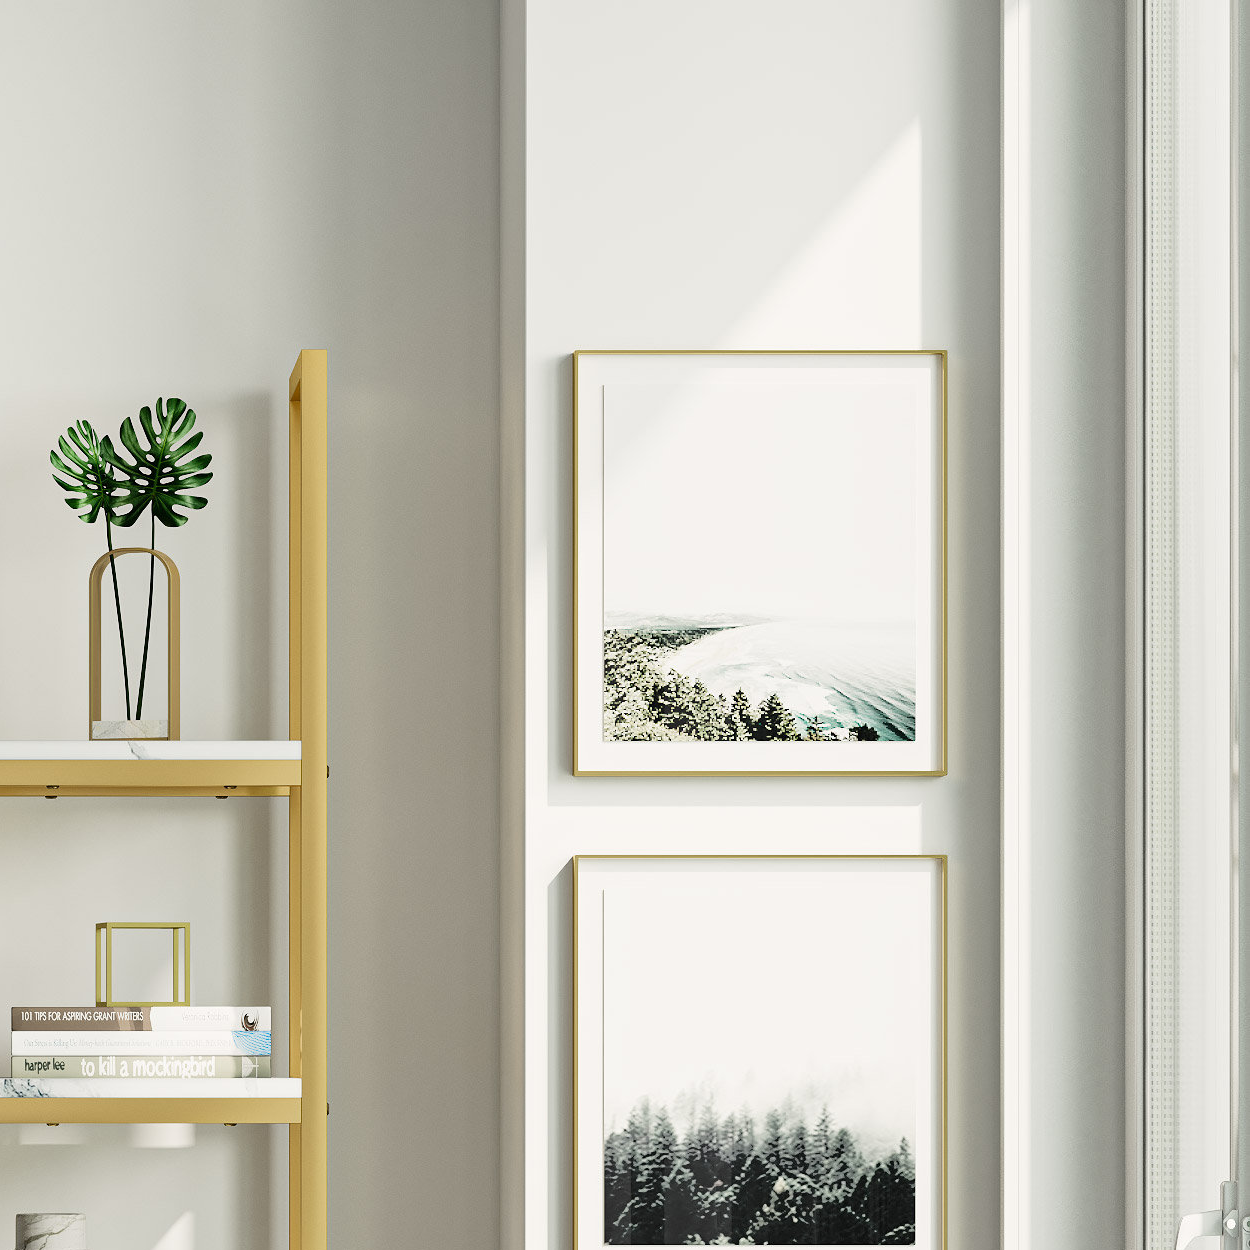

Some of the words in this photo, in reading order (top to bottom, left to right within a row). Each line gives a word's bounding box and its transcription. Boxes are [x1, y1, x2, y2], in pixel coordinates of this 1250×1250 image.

[21, 1011, 32, 1020] 101
[34, 1011, 46, 1021] TIPS
[48, 1011, 61, 1020] FOR
[62, 1011, 92, 1021] ASPIRING
[93, 1011, 116, 1021] GRANT
[116, 1011, 144, 1022] WRITERS
[24, 1058, 50, 1074] harper
[52, 1058, 65, 1070] lee
[81, 1058, 95, 1076] to
[99, 1056, 116, 1076] kill
[120, 1060, 130, 1076] a
[133, 1056, 216, 1078] mockingbird
